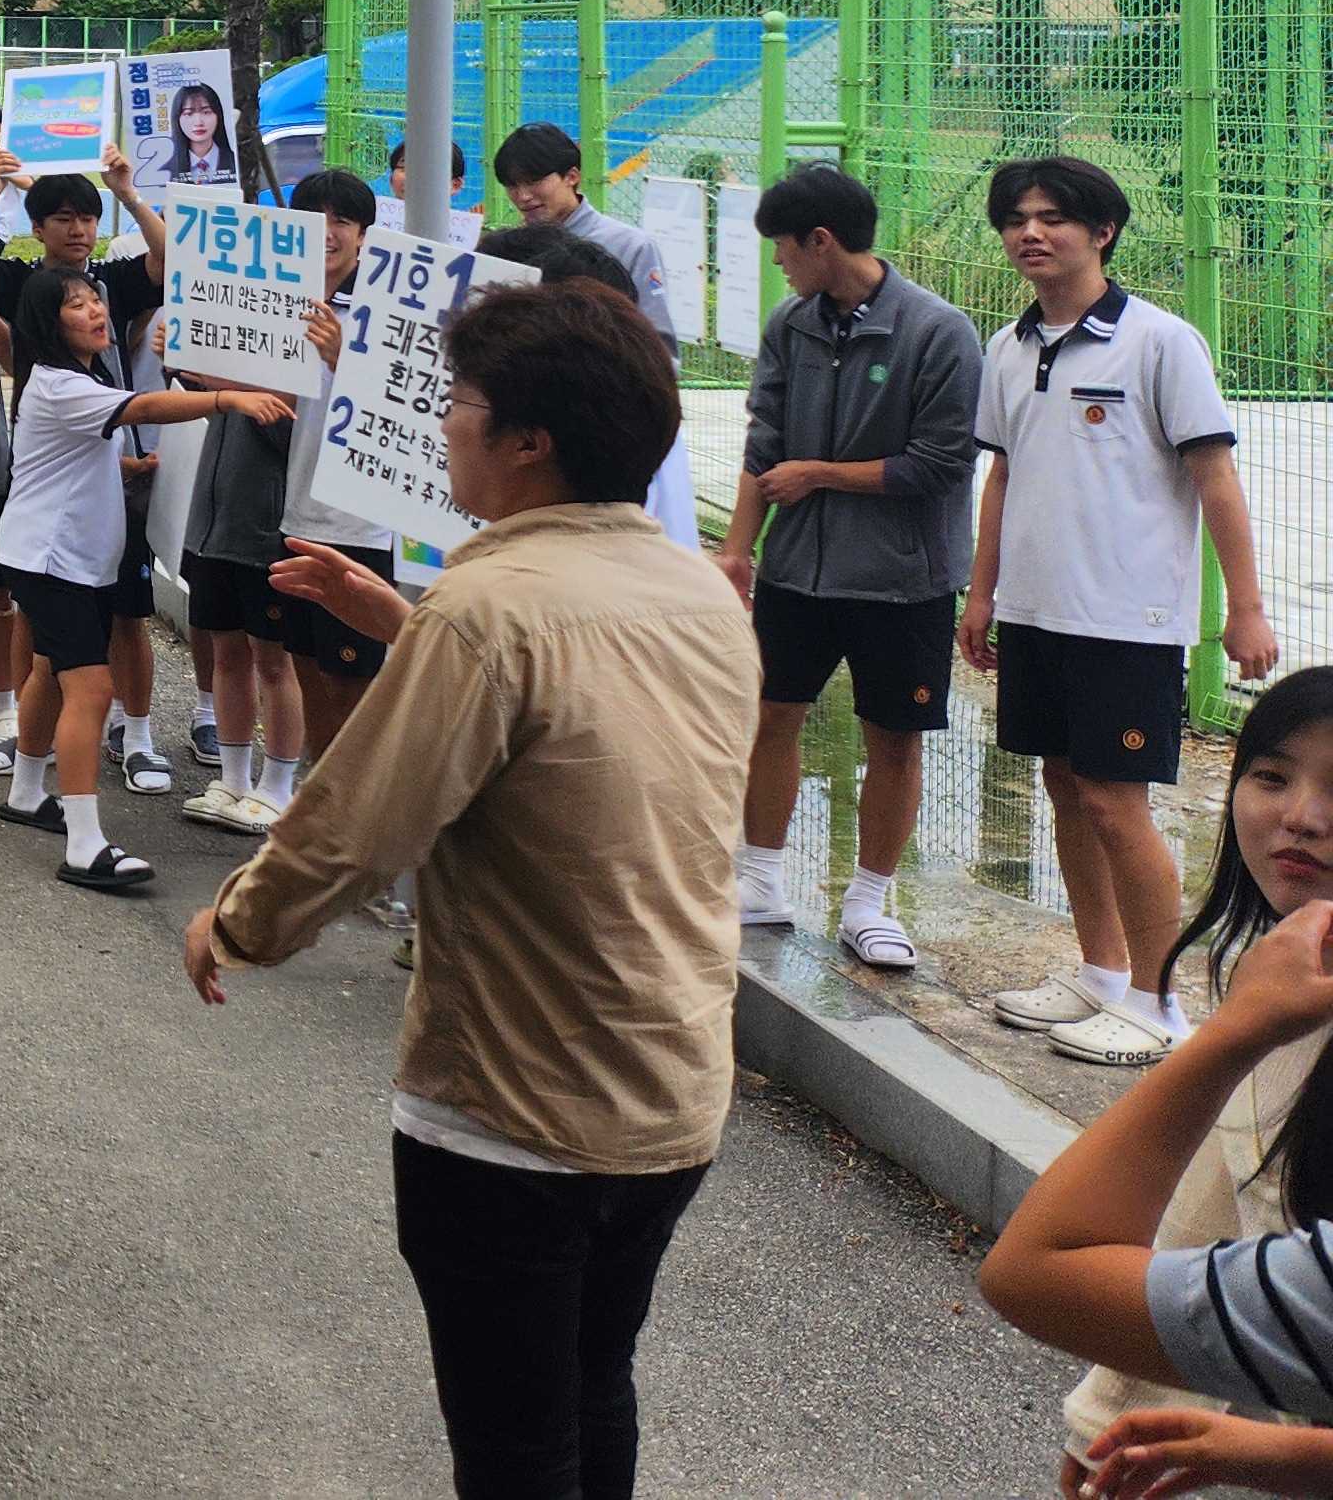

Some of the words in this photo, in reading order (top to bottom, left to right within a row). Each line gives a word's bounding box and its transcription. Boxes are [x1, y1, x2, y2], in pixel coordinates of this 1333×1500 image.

[171, 271, 184, 304] 1
[190, 280, 234, 307] 쓰이지
[238, 286, 257, 312] 않는
[261, 289, 282, 315] 공간
[168, 317, 181, 350] 2
[190, 319, 231, 350] 문태고
[282, 334, 305, 363] 실시
[348, 305, 372, 354] 1
[327, 395, 354, 447] 2
[356, 410, 416, 456] 고장난
[344, 447, 397, 486] 재정비
